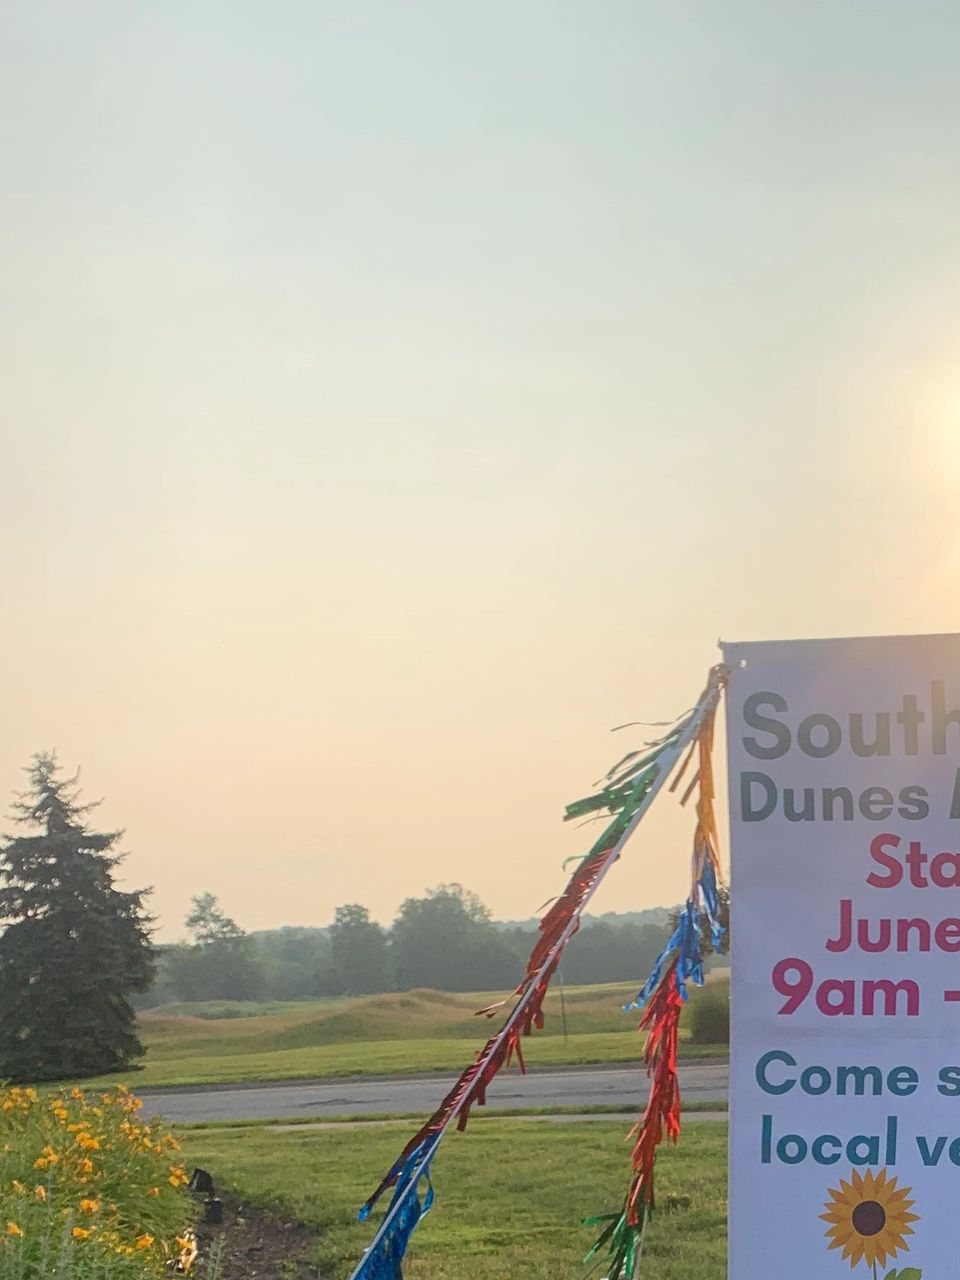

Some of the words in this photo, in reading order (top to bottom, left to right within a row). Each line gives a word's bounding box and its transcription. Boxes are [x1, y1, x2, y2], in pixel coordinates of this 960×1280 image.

[740, 772, 929, 822] Dunes
[772, 958, 919, 1016] 9am
[756, 1050, 918, 1096] Come
[761, 1115, 897, 1165] local
